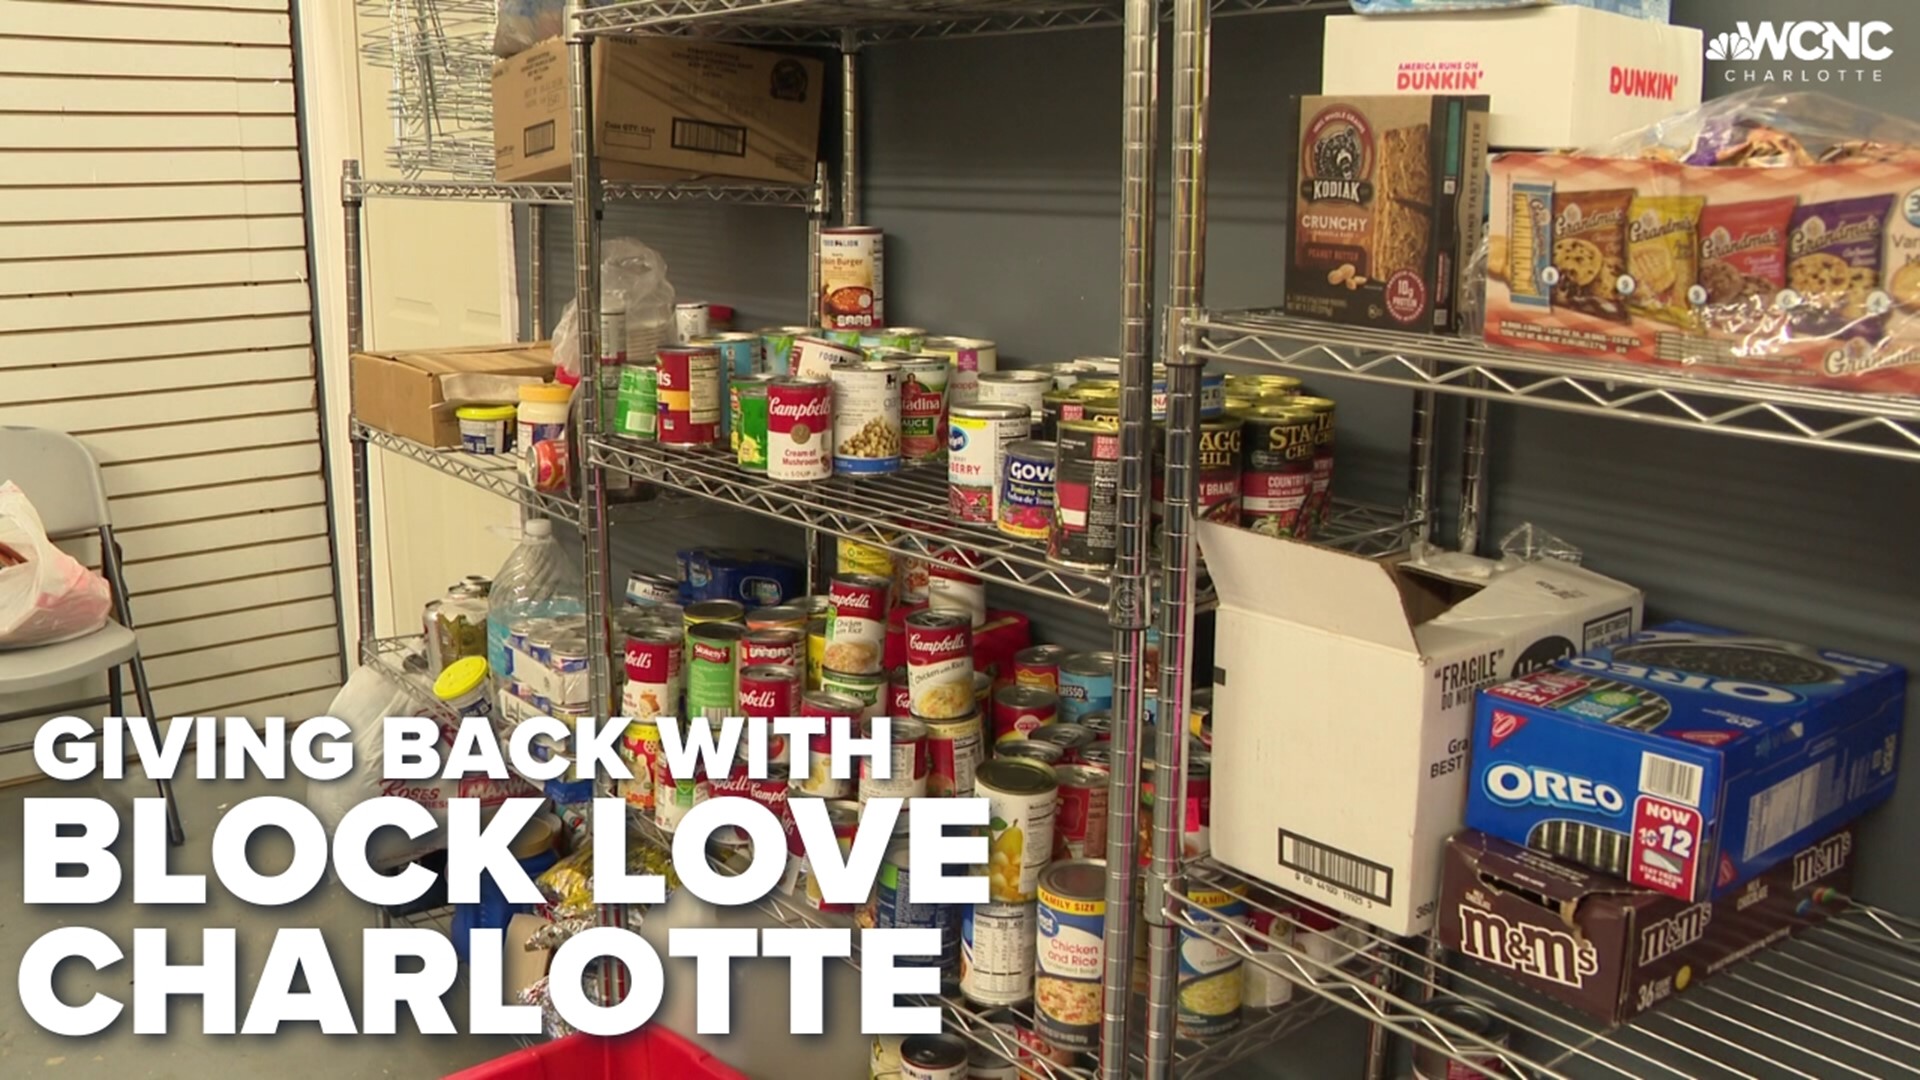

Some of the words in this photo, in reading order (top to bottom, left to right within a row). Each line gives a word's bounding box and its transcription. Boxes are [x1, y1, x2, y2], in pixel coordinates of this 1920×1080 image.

[1398, 62, 1436, 71] AMERICA
[1438, 62, 1462, 71] RUNS
[1464, 62, 1478, 71] ON
[1397, 70, 1484, 90] DUNKIN'
[1609, 66, 1678, 101] DUNKIN'
[1471, 122, 1481, 168] BETTER
[1313, 180, 1361, 203] KODIAK
[1467, 169, 1479, 208] TASTE
[1301, 215, 1368, 232] CRUNCHY
[1701, 227, 1780, 260] Grandma's
[1791, 215, 1881, 256] Grandma's
[1308, 248, 1333, 260] PEANUT
[1334, 249, 1360, 261] BUTTER
[1392, 296, 1417, 308] PROTEIN
[782, 457, 820, 466] Mushroom
[784, 449, 808, 457] Cream
[808, 449, 817, 457] of
[790, 469, 812, 478] SOUP
[1267, 475, 1302, 488] COUNTRY
[1206, 481, 1235, 496] BRAND
[837, 619, 862, 629] Chicken
[847, 627, 863, 635] Rice
[909, 632, 966, 655] Campbell's
[914, 668, 940, 686] Chicken
[951, 660, 966, 672] Rice
[1569, 656, 1799, 705] OREO
[1430, 754, 1463, 780] BEST
[379, 778, 441, 798] ROSES
[1486, 763, 1624, 813] OREO
[1645, 802, 1692, 826] NOW
[1658, 824, 1693, 859] 12
[1639, 864, 1658, 876] STAY
[1658, 867, 1684, 884] FRESH
[1644, 873, 1678, 890] PACKS
[1041, 890, 1072, 912] FAMILY
[1074, 904, 1096, 913] SIZE
[1050, 937, 1099, 956] Chicken
[1047, 951, 1071, 966] and
[1071, 953, 1098, 967] Rice
[1637, 980, 1655, 1011] 36
